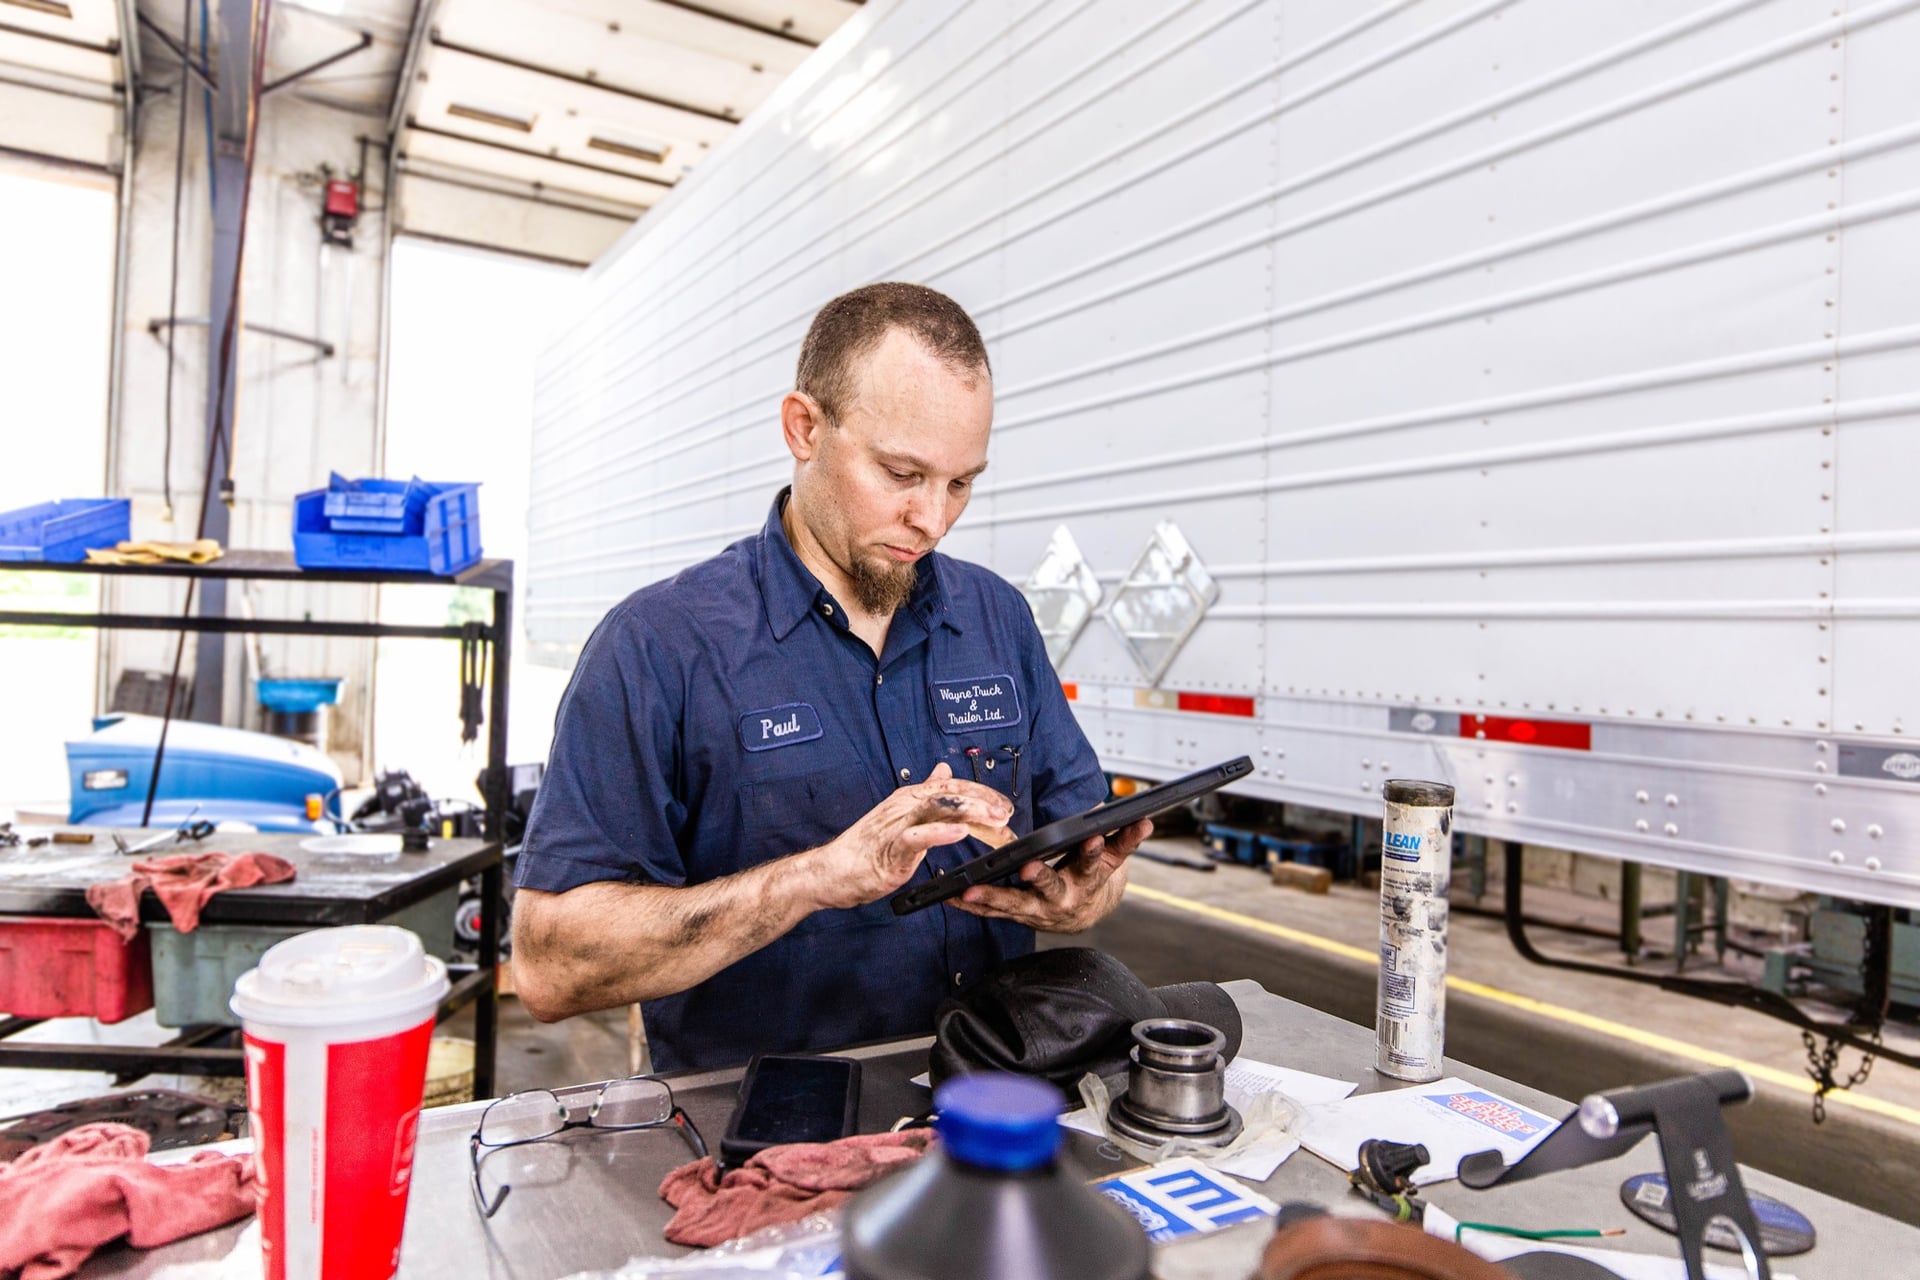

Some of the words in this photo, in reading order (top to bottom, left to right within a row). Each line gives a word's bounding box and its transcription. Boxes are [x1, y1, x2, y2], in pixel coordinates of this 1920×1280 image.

[939, 688, 973, 704] Wayne
[972, 684, 1003, 698] Truck
[969, 699, 978, 711] &
[760, 713, 800, 739] Paul
[948, 711, 983, 725] Trailer
[984, 708, 1005, 721] Ltd.
[1385, 831, 1422, 850] LEAN
[1447, 1100, 1517, 1133] GLASS
[1450, 1094, 1538, 1133] SERVICE
[1482, 1101, 1521, 1118] ALL
